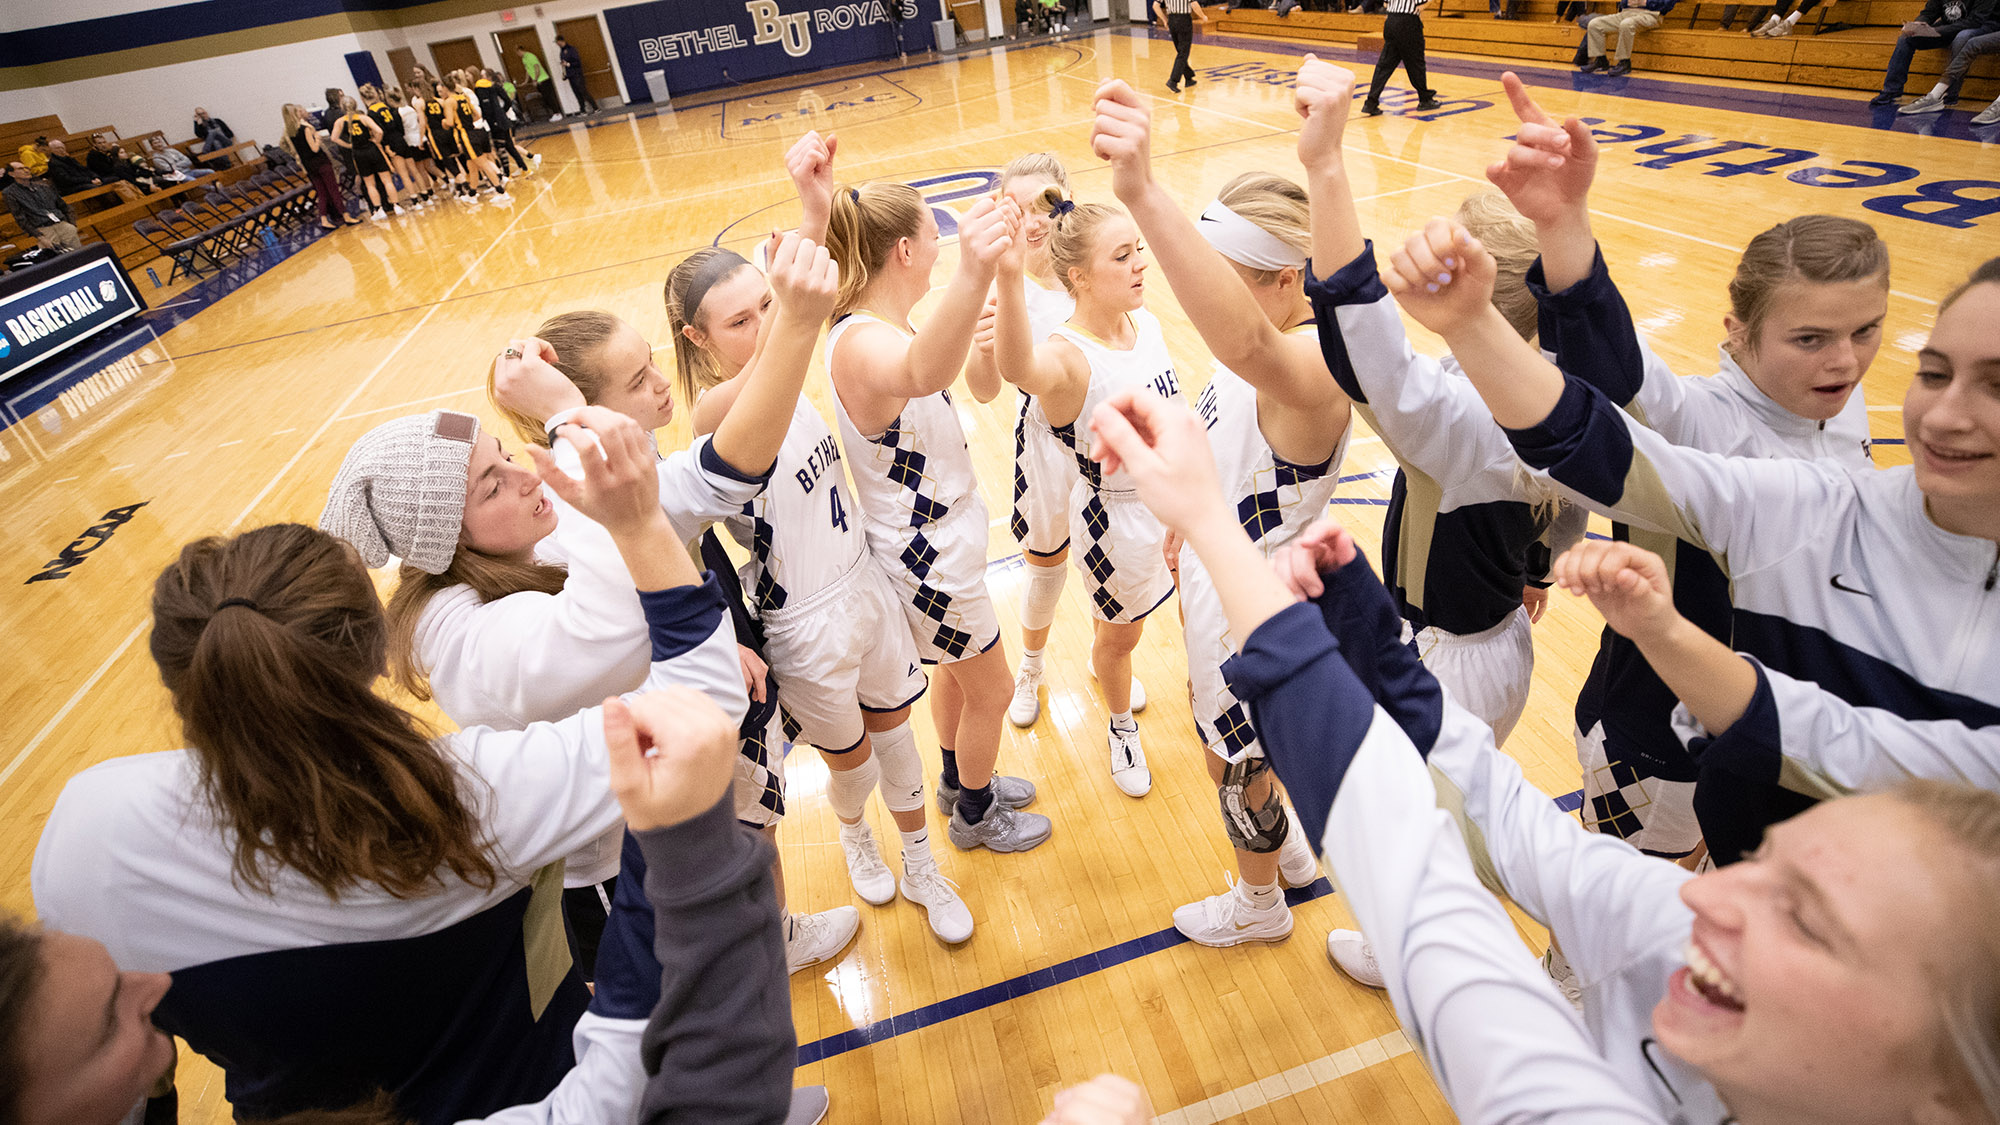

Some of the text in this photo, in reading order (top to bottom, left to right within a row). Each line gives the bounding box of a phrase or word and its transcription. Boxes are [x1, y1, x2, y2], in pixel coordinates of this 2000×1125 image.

[639, 0, 919, 63] BETHEL BU ROYAS
[427, 101, 442, 115] 33
[1503, 116, 2000, 229] Bethe
[5, 286, 103, 347] BASKETBALL
[795, 434, 841, 495] BETHEL
[829, 485, 849, 533] 4
[23, 496, 156, 585] NCAA
